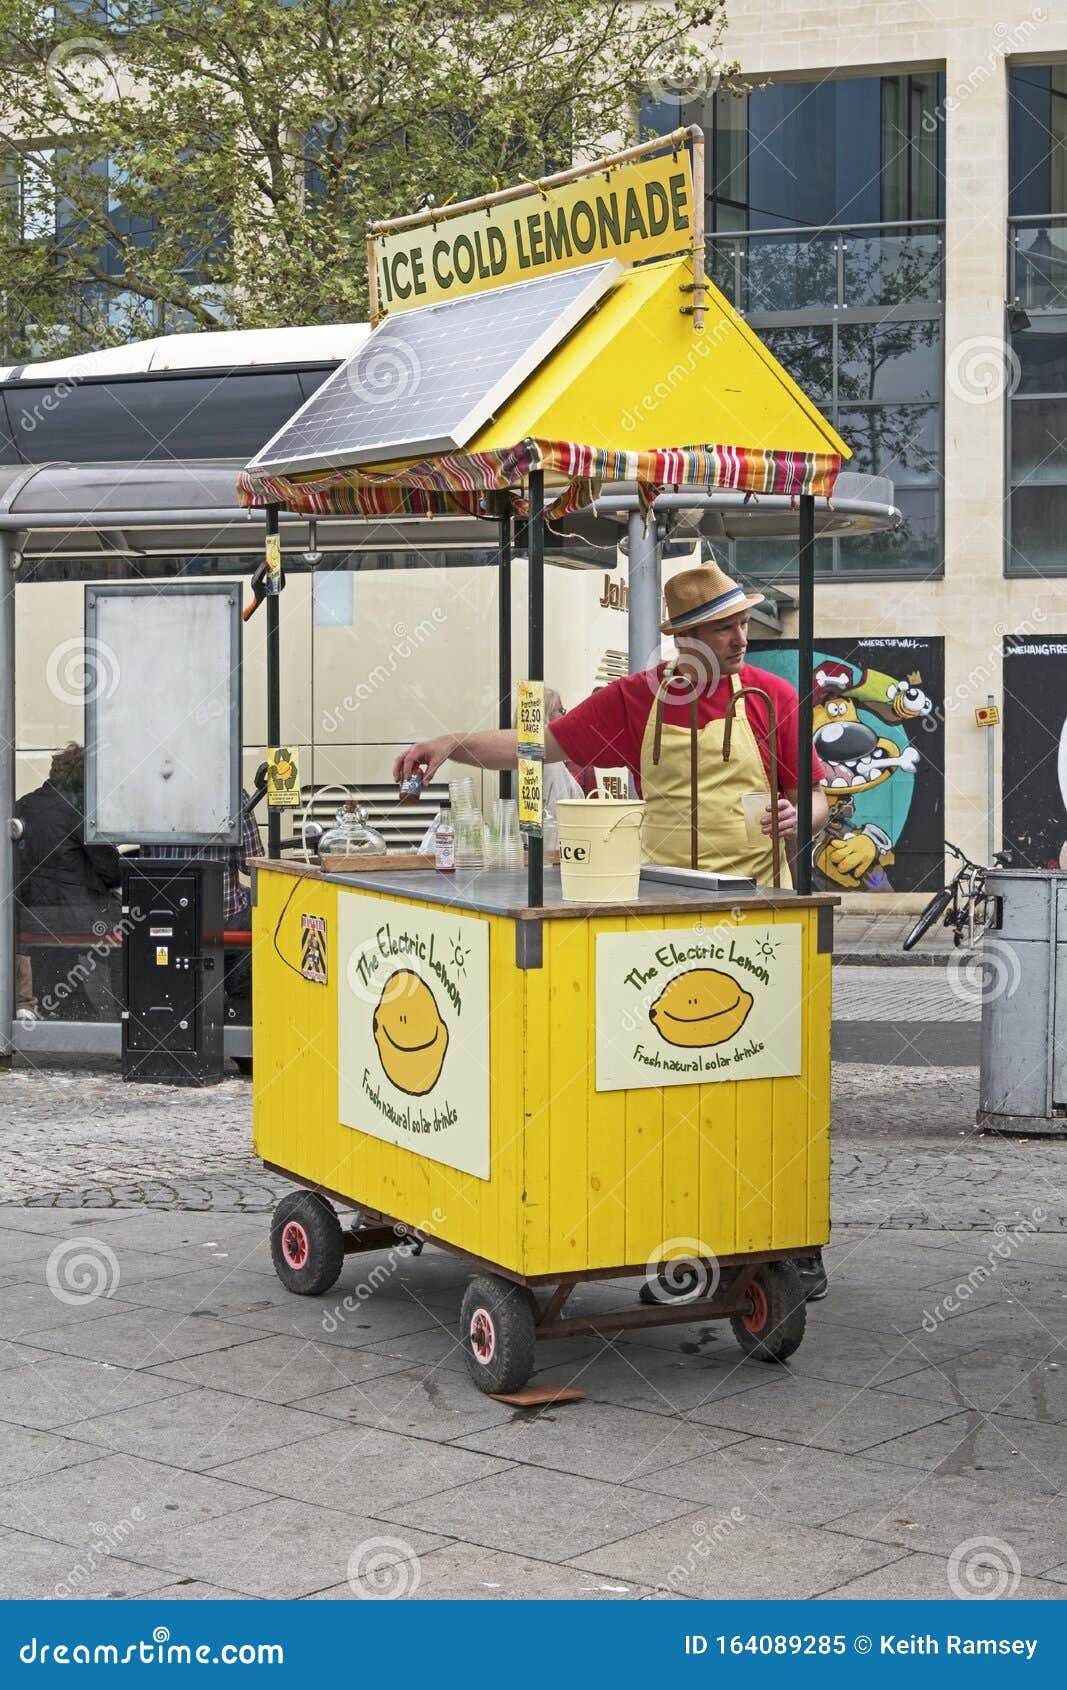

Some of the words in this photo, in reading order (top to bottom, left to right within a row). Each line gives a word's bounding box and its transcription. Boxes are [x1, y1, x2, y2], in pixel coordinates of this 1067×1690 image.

[382, 247, 426, 301] ICE
[432, 226, 507, 289] COLD
[514, 173, 689, 269] LEMONADE
[600, 574, 629, 609] Joh
[521, 708, 541, 723] £2.50
[523, 723, 539, 734] LARGE
[522, 785, 540, 800] £2.00
[524, 800, 539, 813] SMALL
[356, 951, 379, 987] The
[376, 923, 426, 960] Electric
[429, 933, 461, 1016] Lemon
[624, 967, 658, 990] The
[655, 943, 724, 967] Electric
[729, 940, 770, 985] Lemon
[633, 1044, 661, 1068] Fresh
[663, 1055, 703, 1072] natural
[705, 1052, 731, 1071] solar
[734, 1040, 765, 1062] drinks
[362, 1068, 382, 1110] Fresh
[382, 1101, 411, 1131] natural
[412, 1108, 432, 1134] solar
[433, 1100, 458, 1132] drinks
